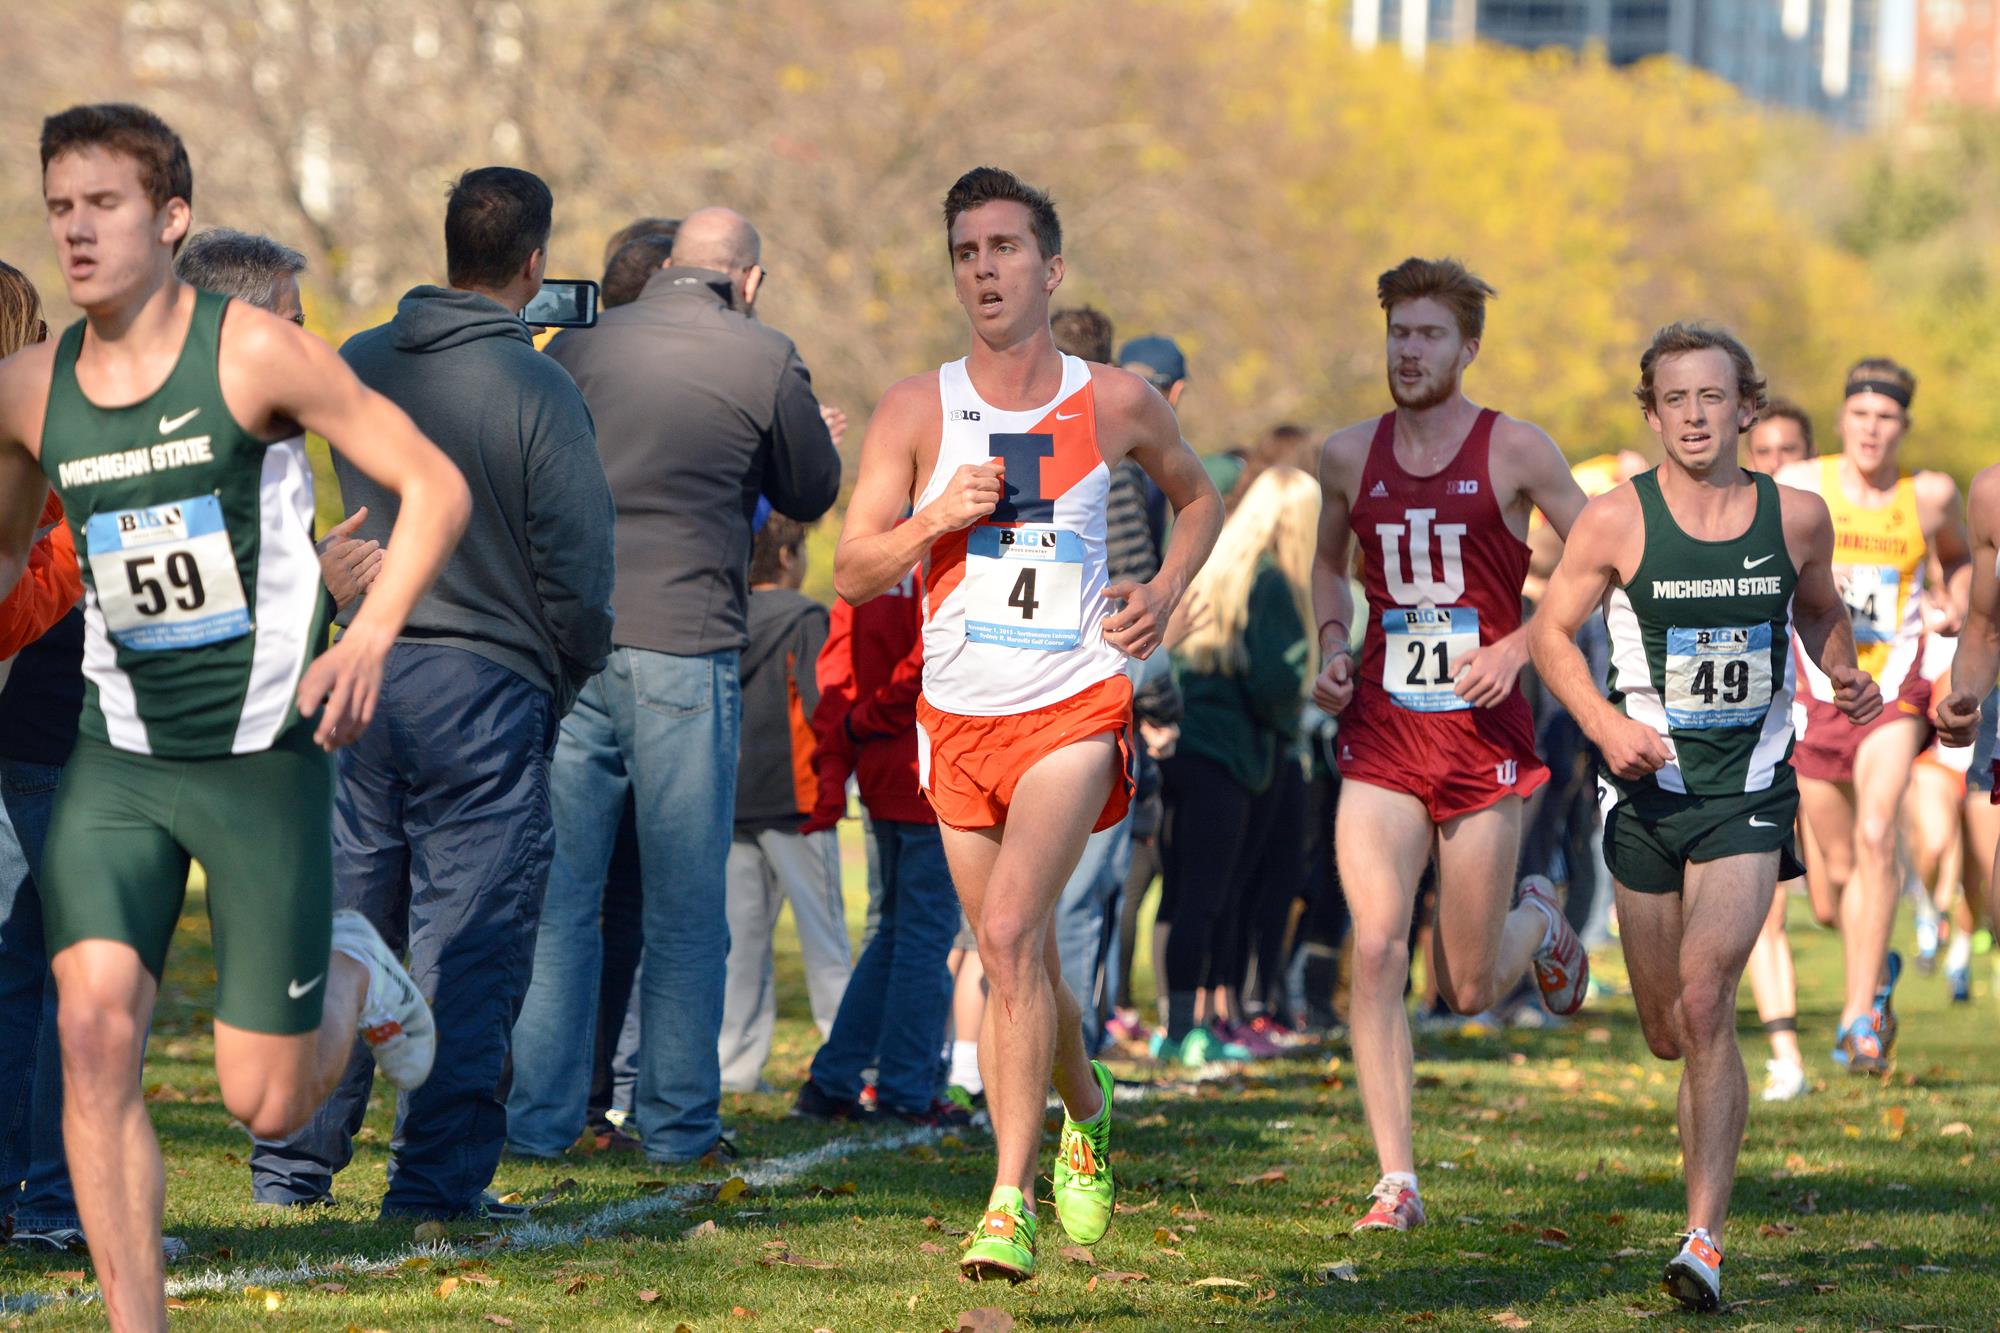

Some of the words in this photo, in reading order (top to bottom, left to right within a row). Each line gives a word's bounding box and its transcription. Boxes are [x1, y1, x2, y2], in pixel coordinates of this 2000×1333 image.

[58, 447, 151, 488] MICHIGAN
[150, 434, 214, 470] STATE
[124, 551, 206, 616] 59
[1008, 568, 1039, 620] 4
[1652, 578, 1735, 599] MICHIGAN
[1738, 576, 1781, 596] STATE
[1406, 641, 1454, 685] 21
[1691, 660, 1748, 704] 49
